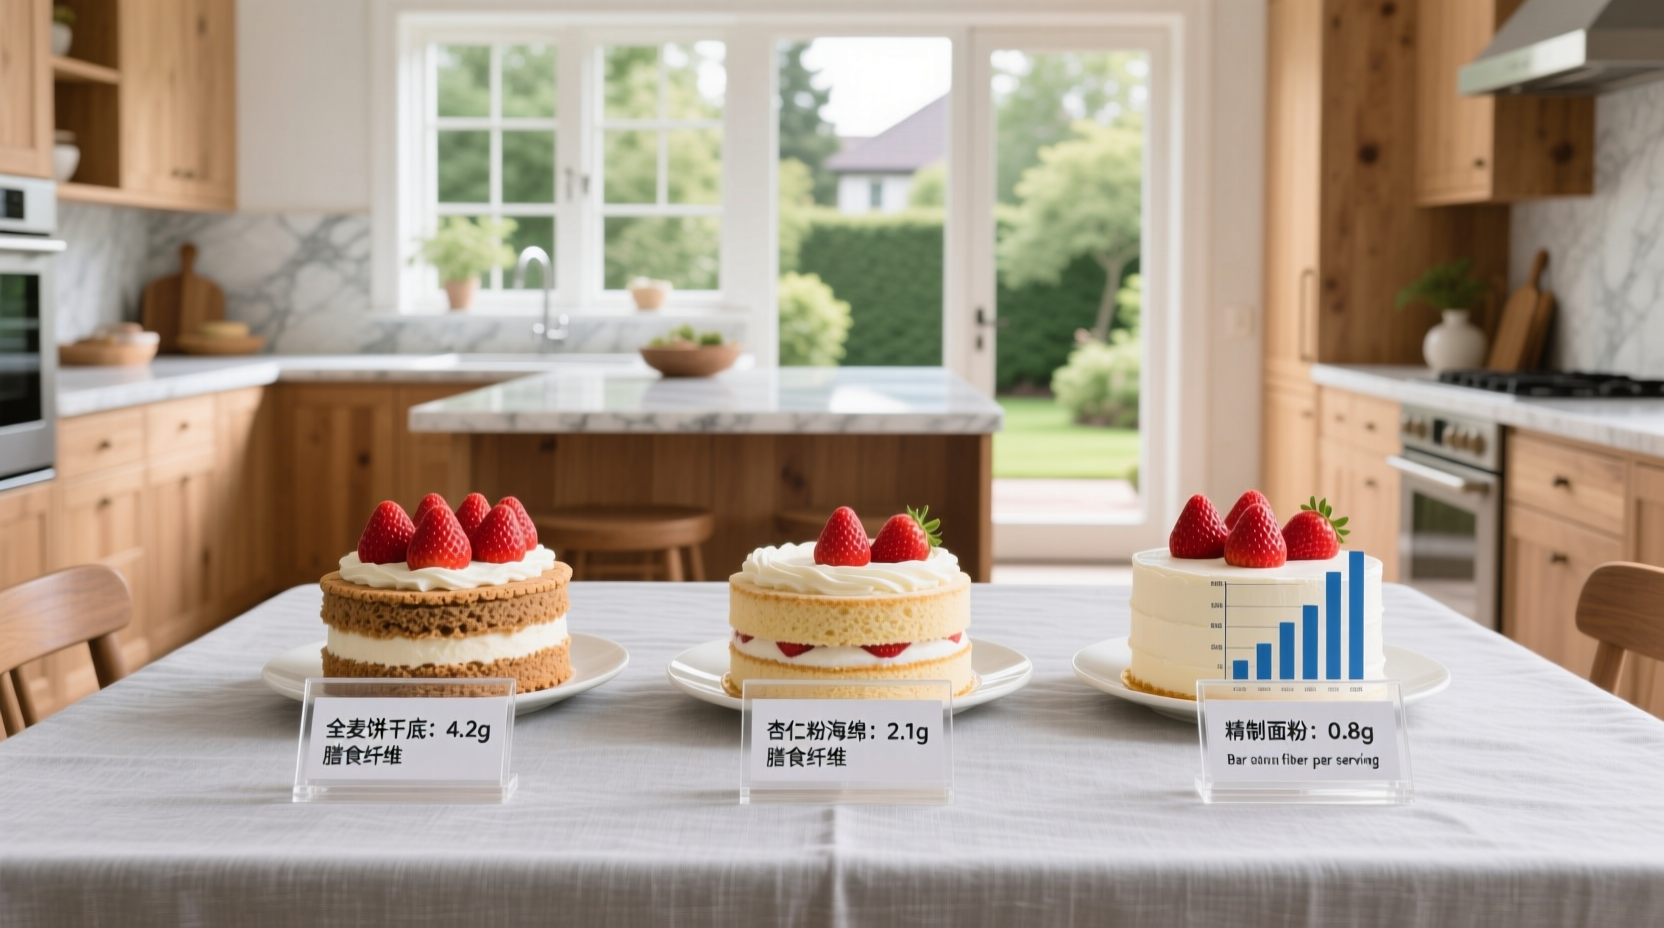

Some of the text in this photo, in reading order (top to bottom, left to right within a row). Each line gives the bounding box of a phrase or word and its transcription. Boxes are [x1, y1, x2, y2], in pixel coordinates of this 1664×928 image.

[1227, 753, 1247, 766] Bar
[1281, 752, 1309, 766] fiber
[1313, 756, 1333, 770] per
[1336, 752, 1379, 770] serving
